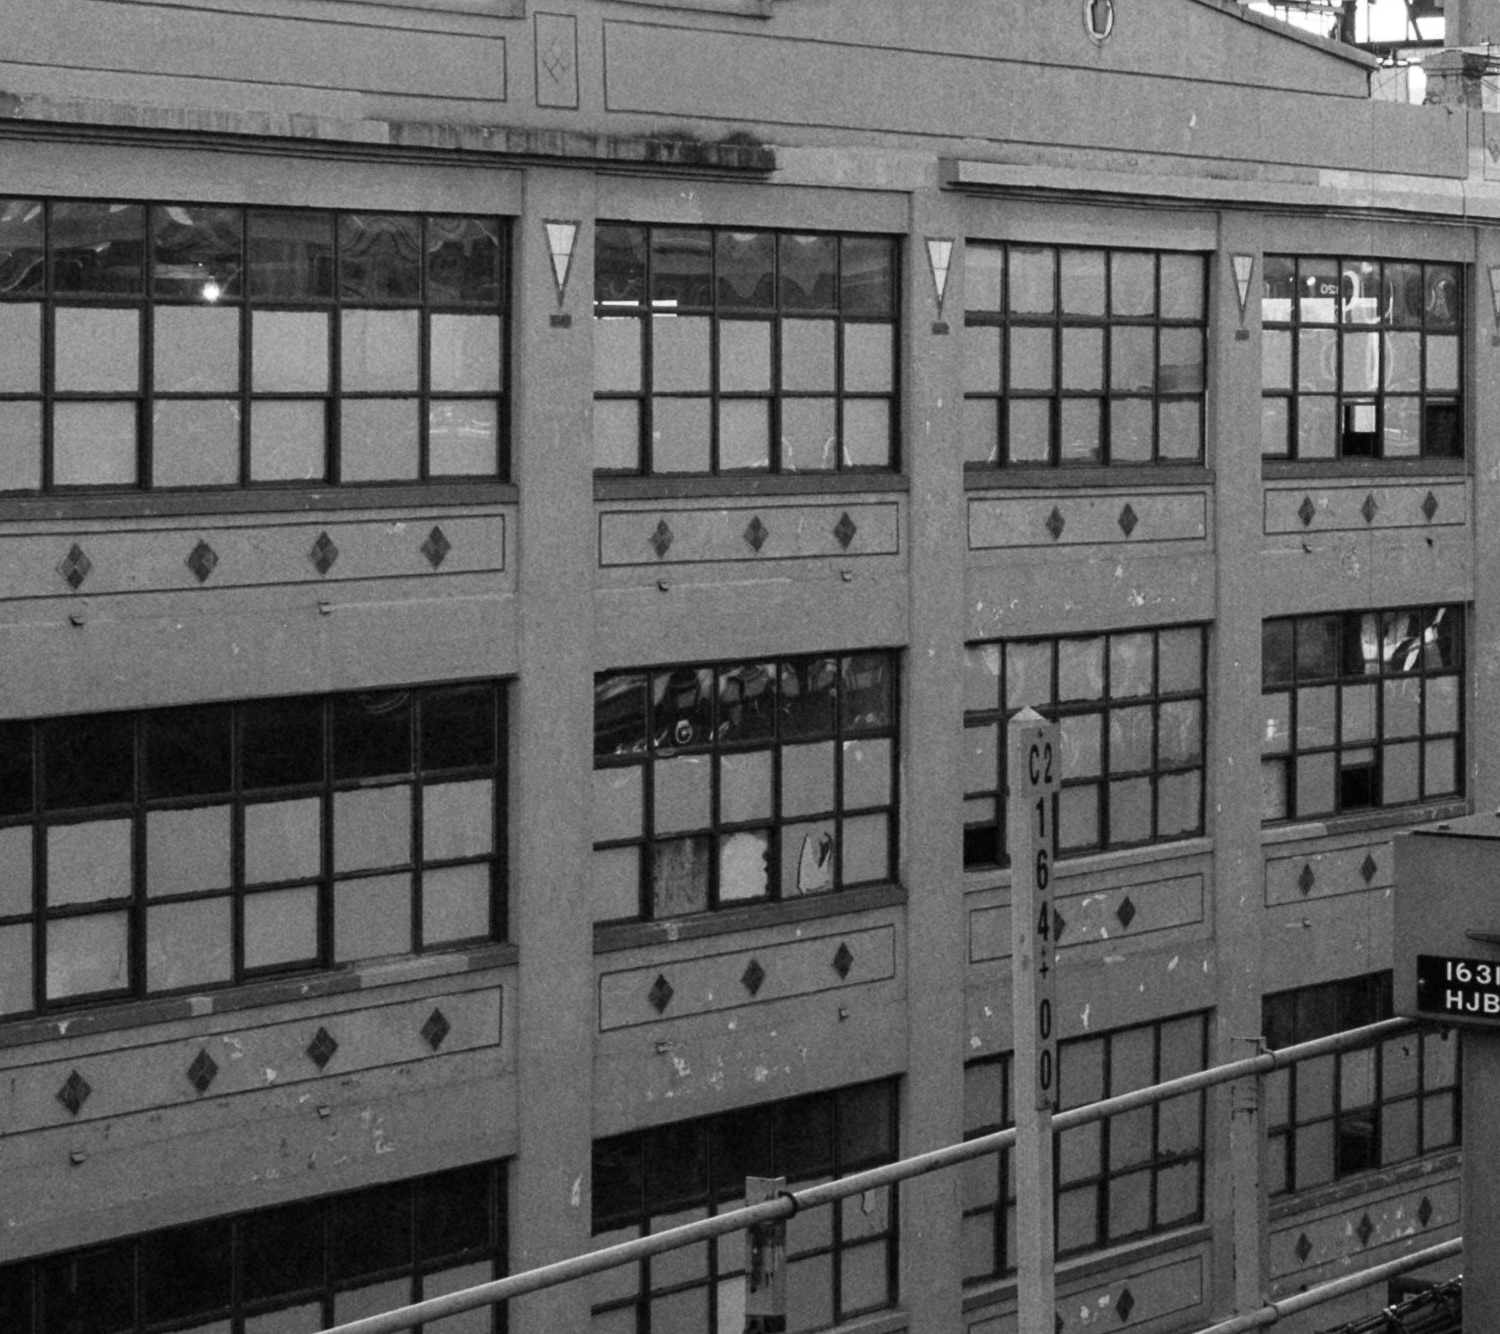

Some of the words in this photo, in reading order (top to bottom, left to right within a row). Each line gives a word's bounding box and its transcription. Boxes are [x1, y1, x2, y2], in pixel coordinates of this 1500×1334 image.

[1029, 742, 1053, 786] C2
[1446, 961, 1500, 986] 1631
[1446, 989, 1500, 1014] HJB
